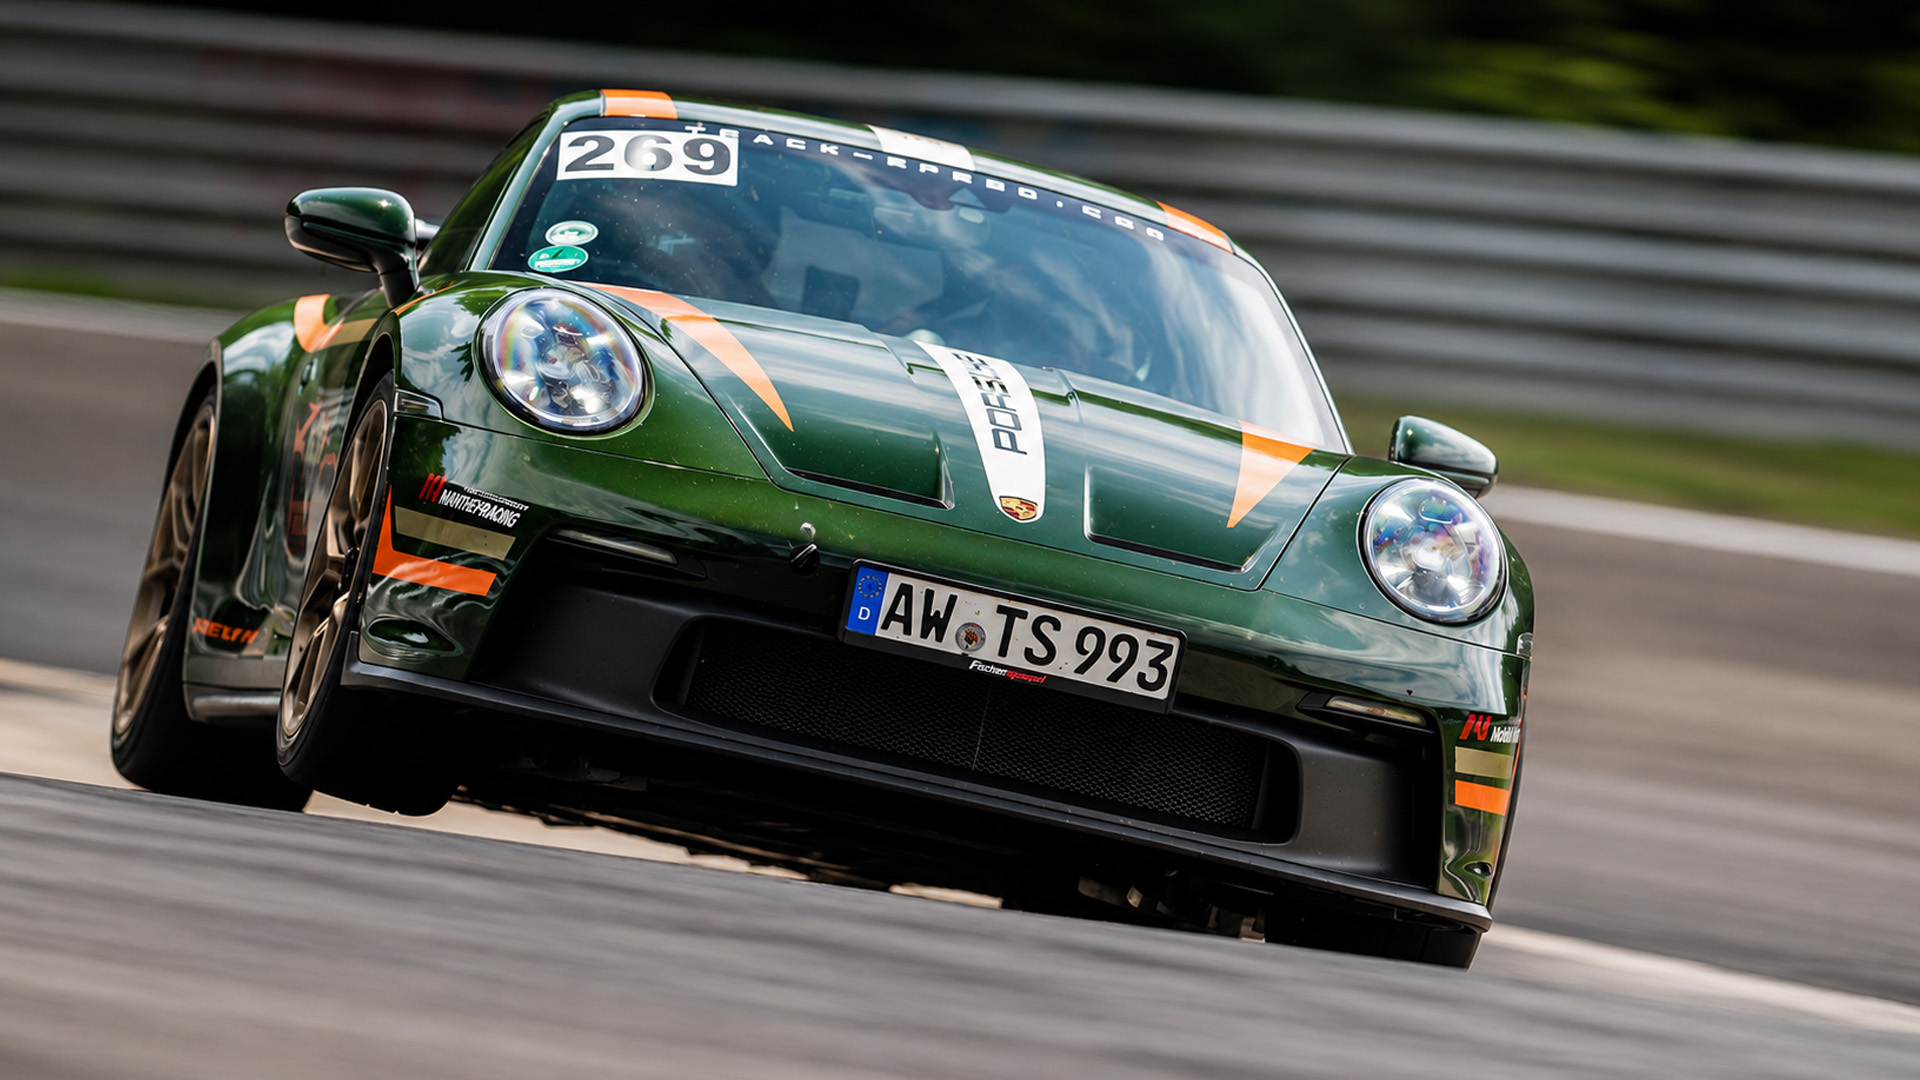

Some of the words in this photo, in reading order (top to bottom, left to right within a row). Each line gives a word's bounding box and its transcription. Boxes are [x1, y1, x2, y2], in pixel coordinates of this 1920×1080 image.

[565, 134, 731, 176] 269
[858, 606, 871, 621] D
[880, 583, 958, 643] AW
[996, 604, 1062, 666] TS
[1073, 626, 1174, 692] 993
